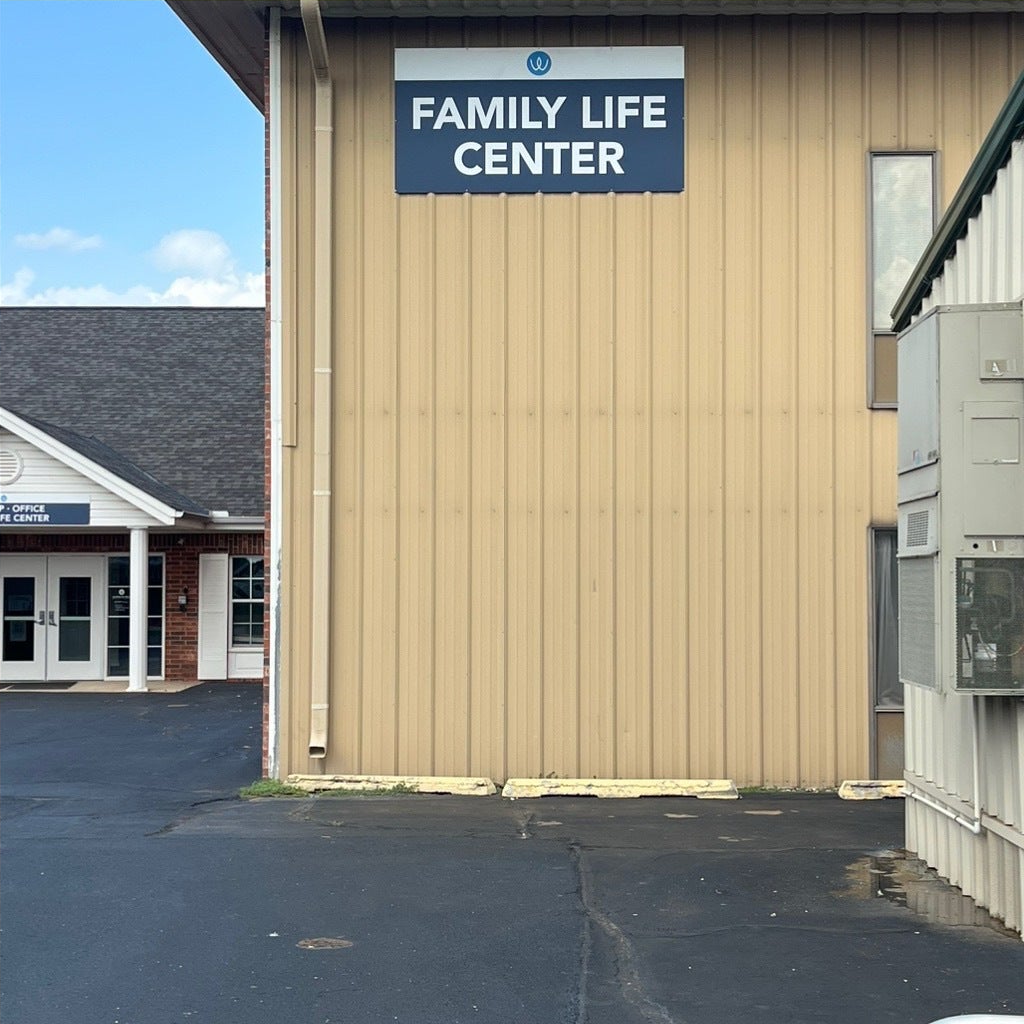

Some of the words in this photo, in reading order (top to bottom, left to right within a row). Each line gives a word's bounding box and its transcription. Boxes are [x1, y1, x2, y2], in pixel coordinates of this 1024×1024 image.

[412, 96, 567, 130] FAMILY
[581, 95, 667, 129] LIFE
[453, 141, 625, 176] CENTER
[12, 504, 46, 513] OFFICE
[13, 514, 50, 522] CENTER
